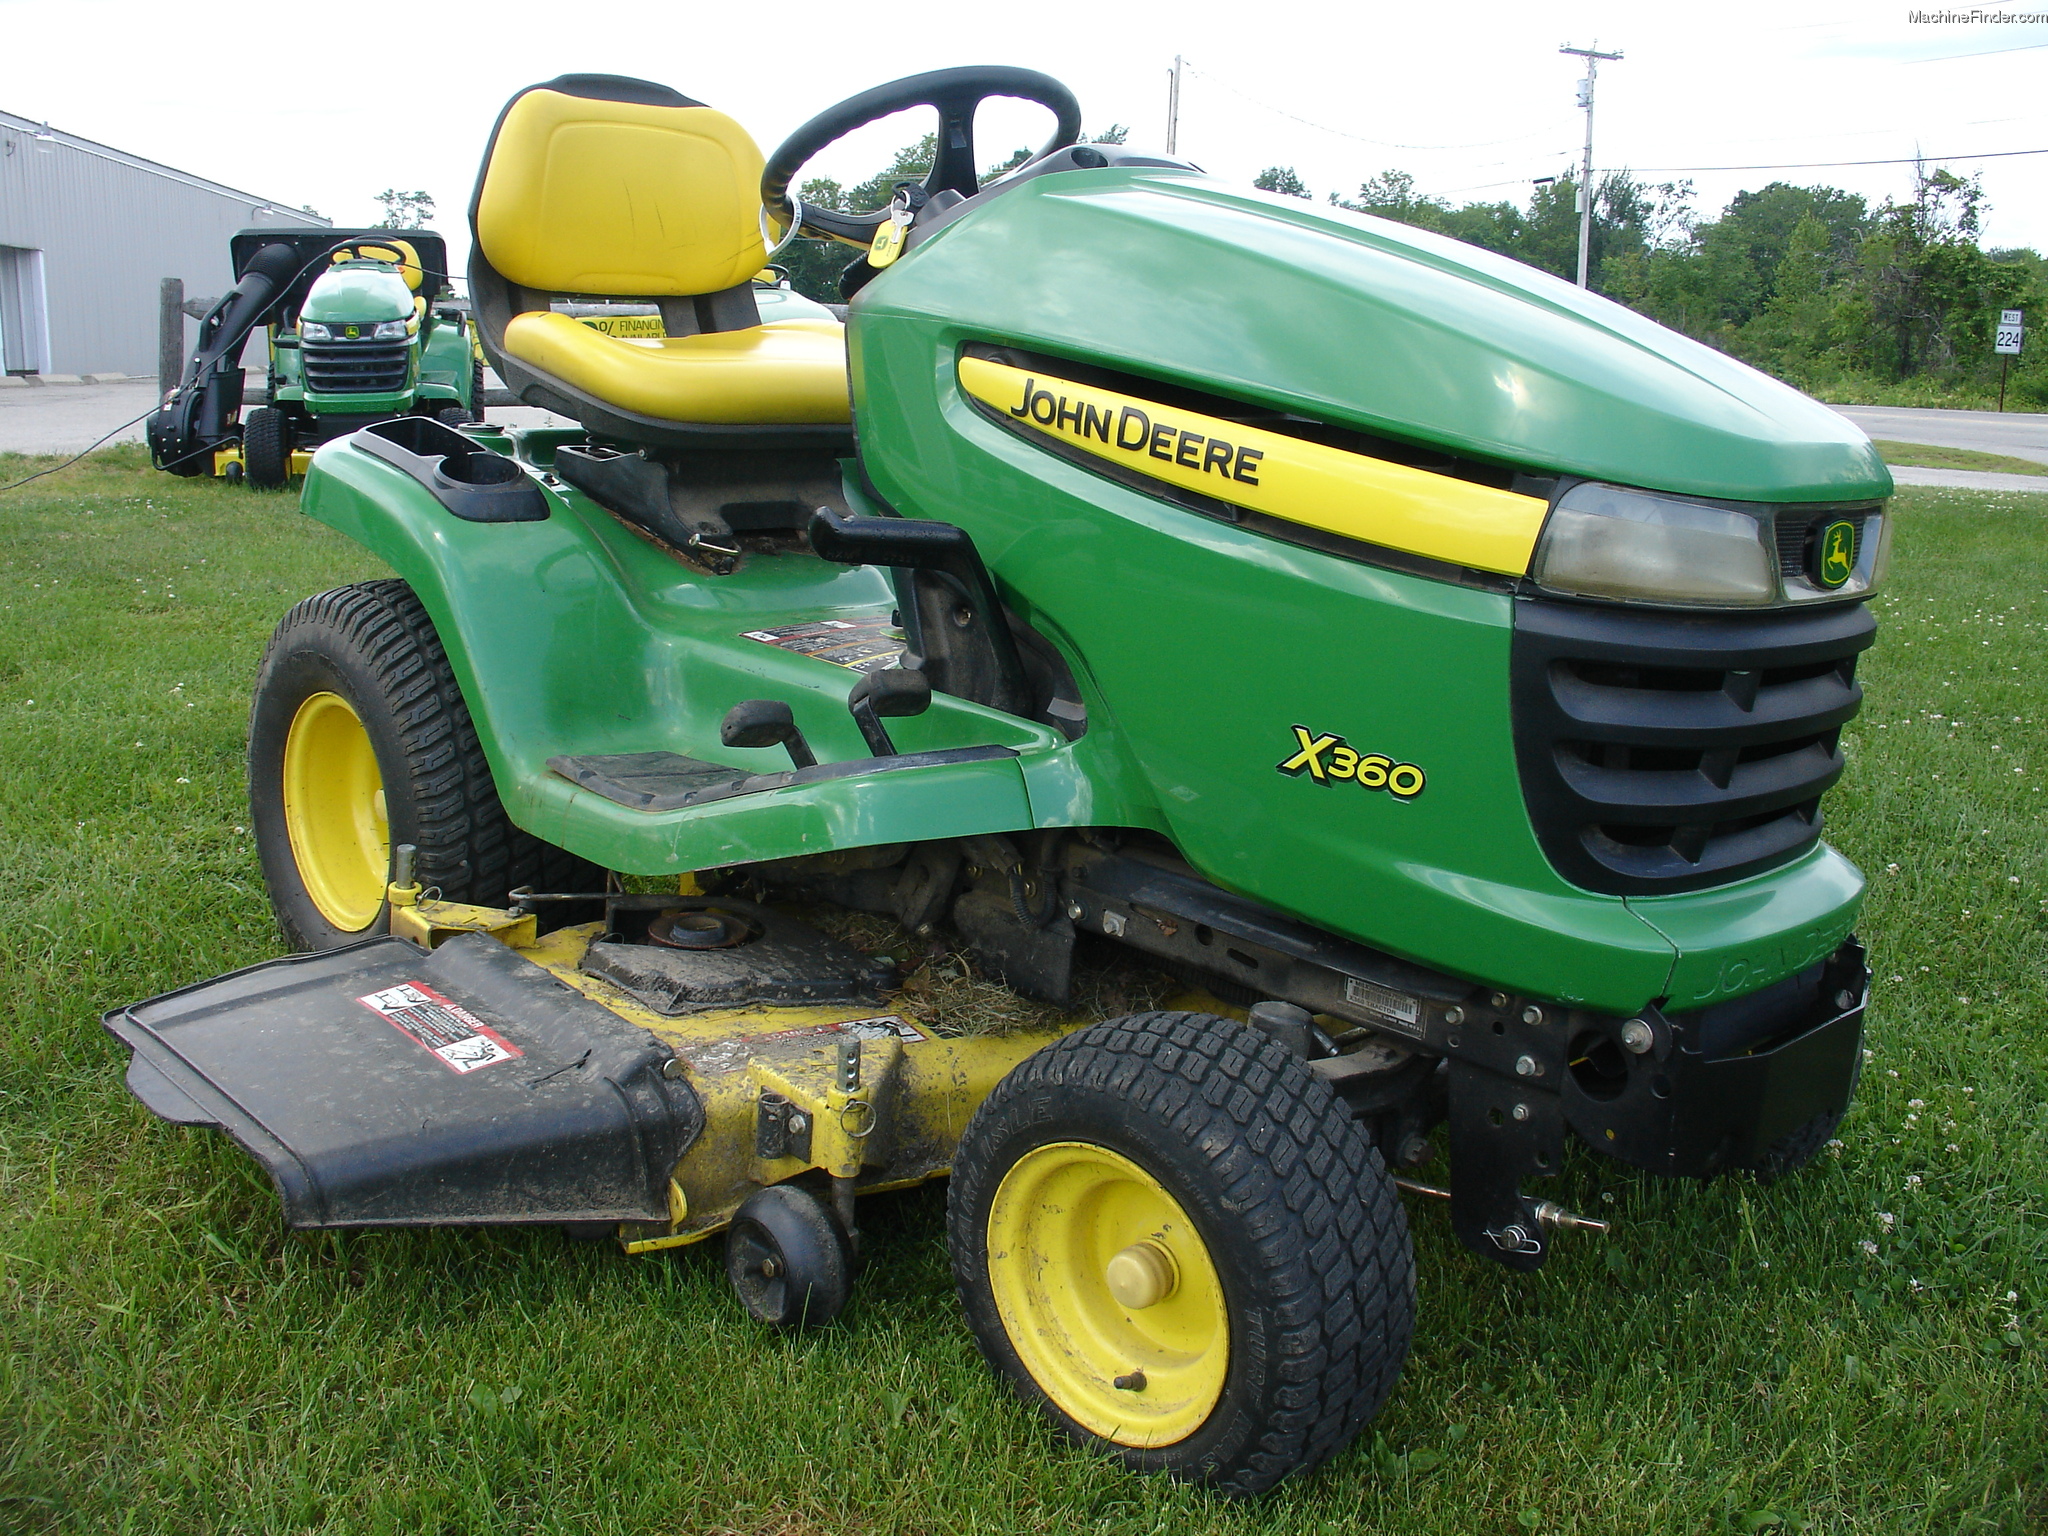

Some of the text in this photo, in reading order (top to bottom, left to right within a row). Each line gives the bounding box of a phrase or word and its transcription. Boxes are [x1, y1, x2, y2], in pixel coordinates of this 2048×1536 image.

[620, 319, 665, 332] FINANCIN
[2003, 313, 2019, 322] WEST
[1997, 331, 2019, 347] 224
[1010, 378, 1264, 487] JOHN DEERE
[1276, 724, 1427, 799] X360
[452, 1006, 485, 1029] DANGER
